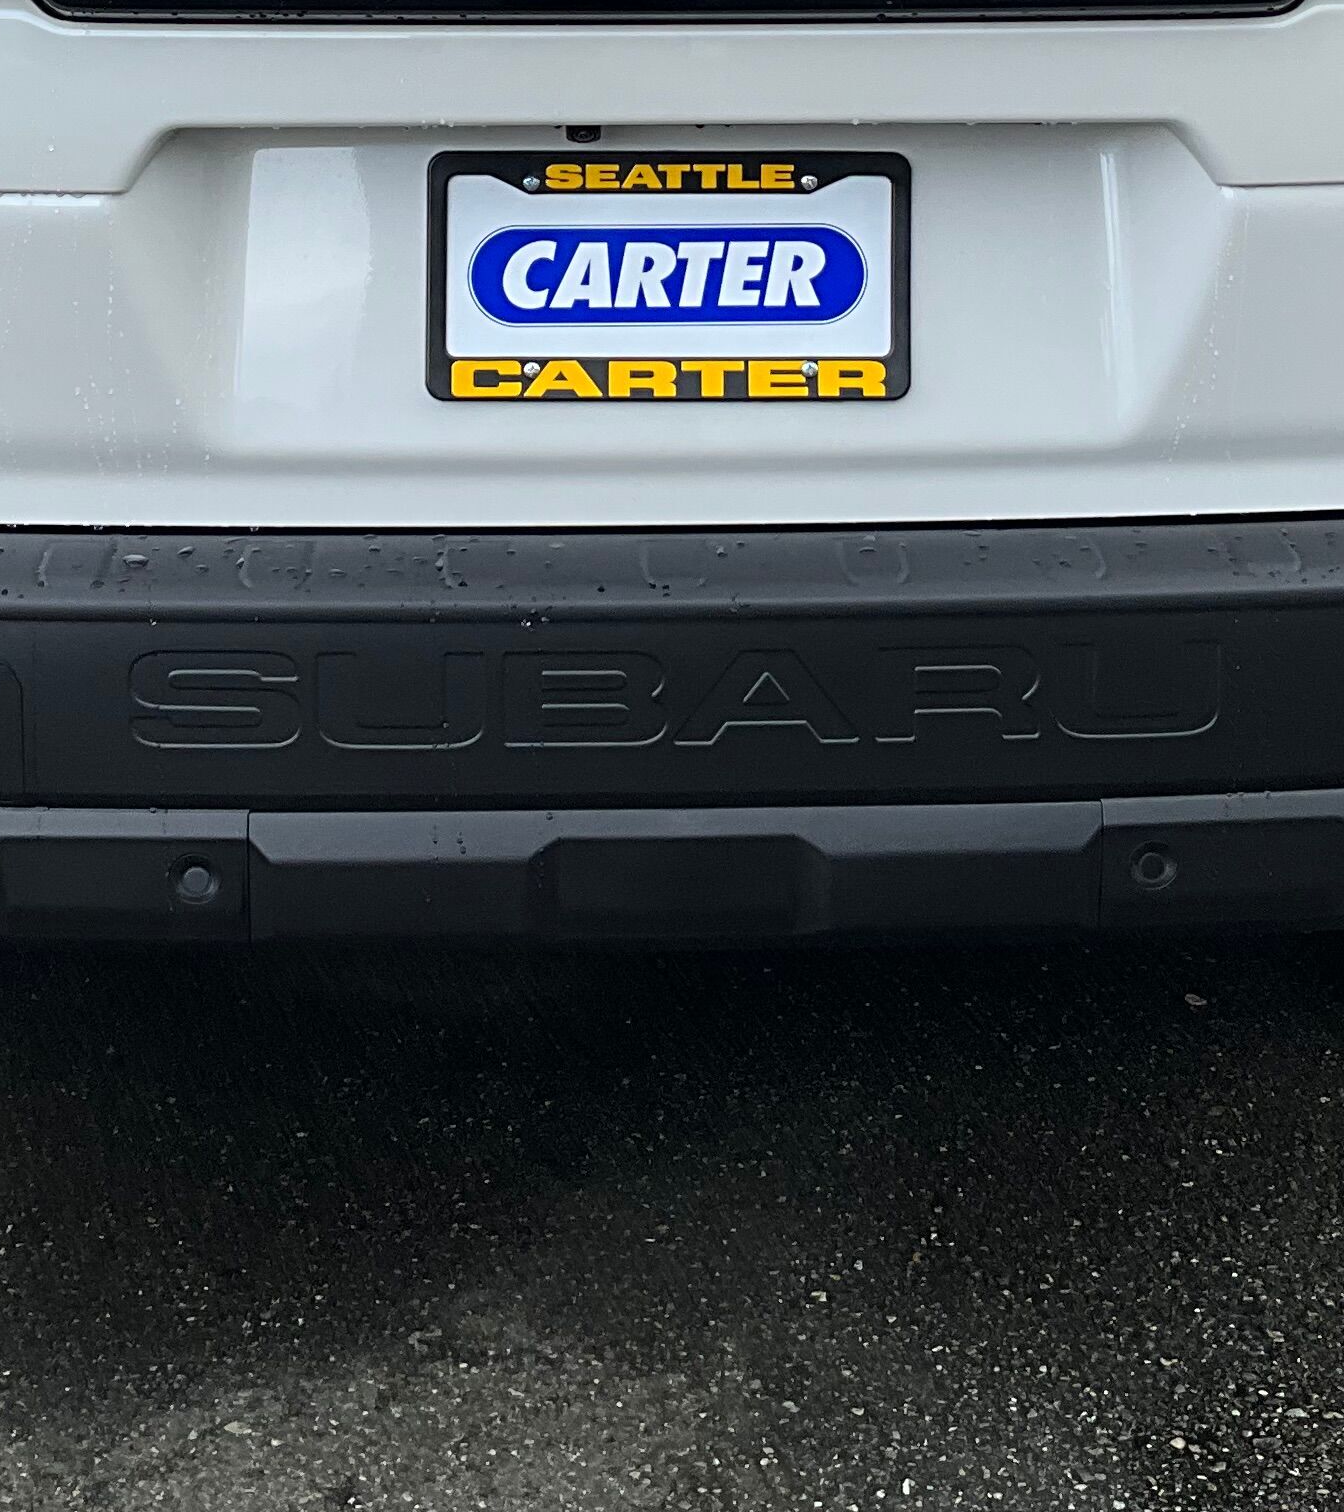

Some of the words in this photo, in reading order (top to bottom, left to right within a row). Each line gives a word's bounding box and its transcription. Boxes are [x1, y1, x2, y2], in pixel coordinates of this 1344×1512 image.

[545, 164, 795, 189] SEATTLE
[502, 240, 826, 309] CARTER
[451, 360, 886, 397] CARTER
[128, 641, 1221, 751] SUBARU
